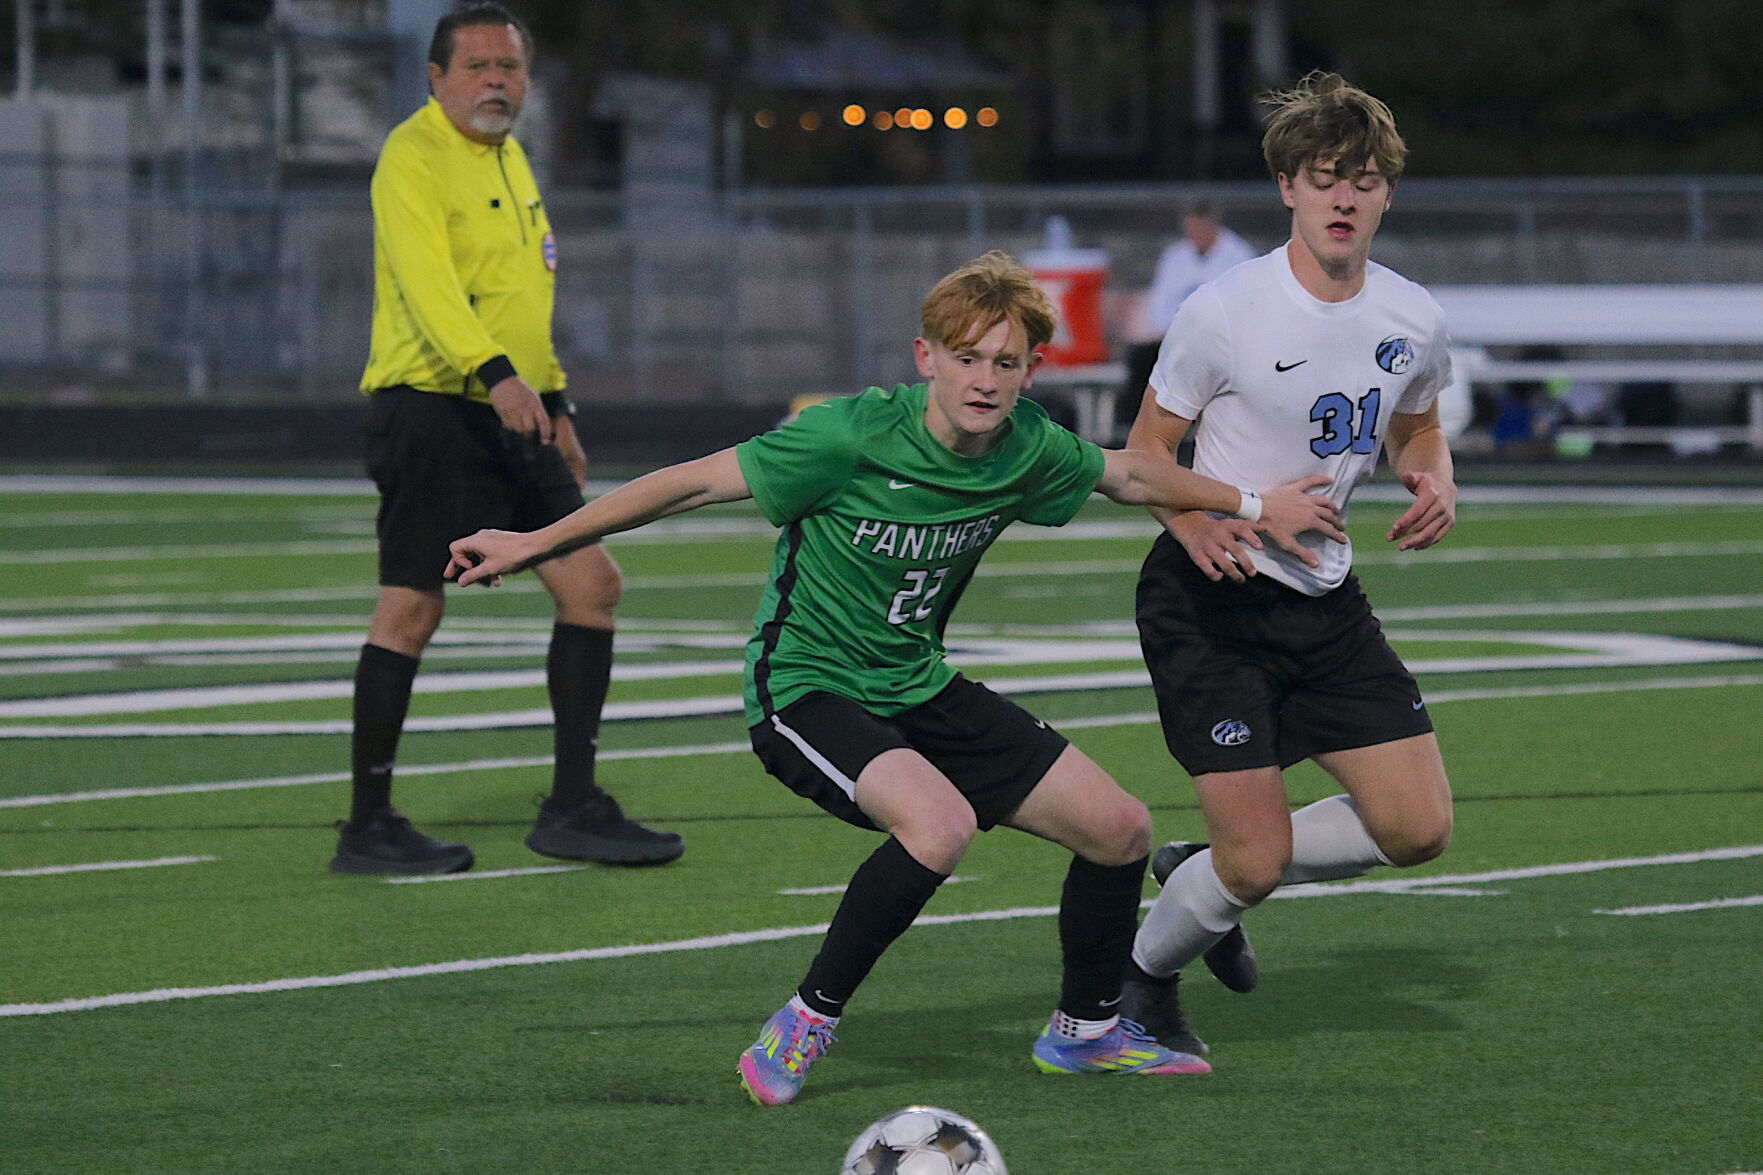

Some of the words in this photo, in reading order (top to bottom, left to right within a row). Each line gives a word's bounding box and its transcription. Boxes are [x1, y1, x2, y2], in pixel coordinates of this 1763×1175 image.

[1310, 388, 1380, 459] 31
[852, 514, 1000, 560] PANTHERS
[887, 567, 949, 625] 22
